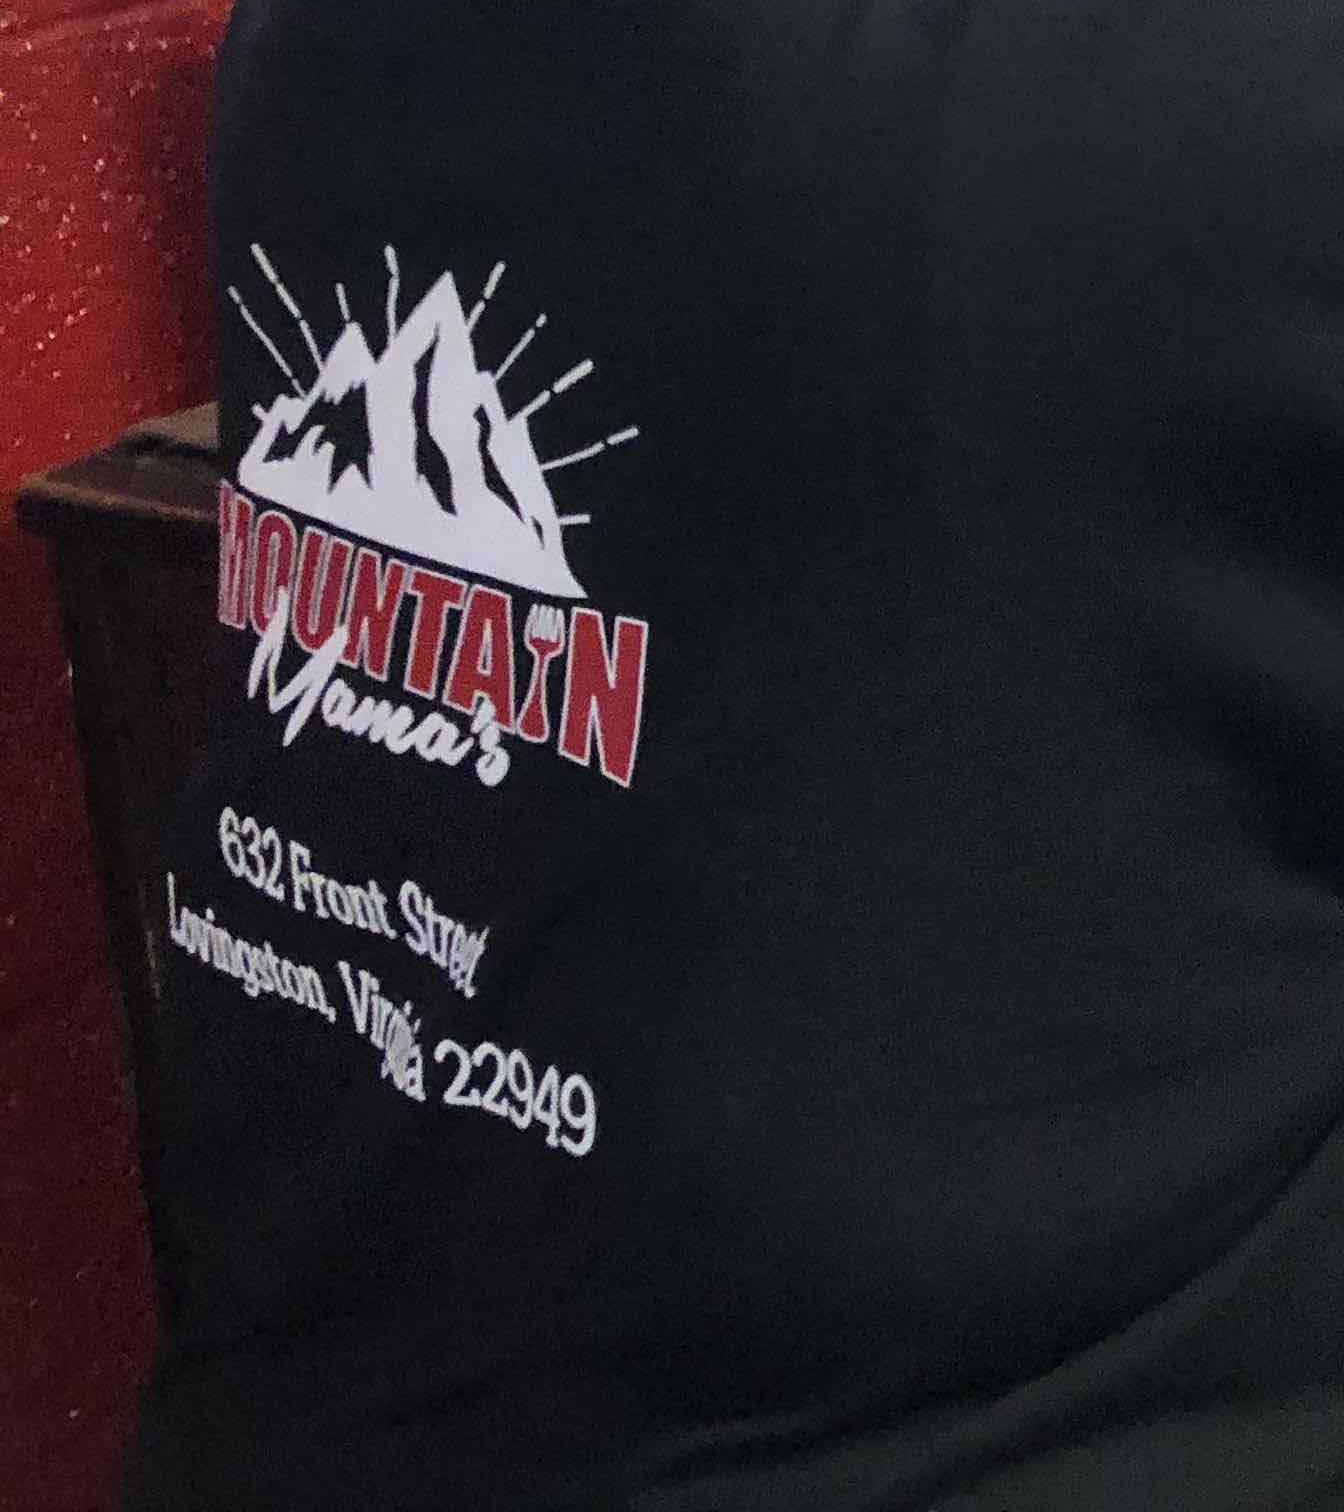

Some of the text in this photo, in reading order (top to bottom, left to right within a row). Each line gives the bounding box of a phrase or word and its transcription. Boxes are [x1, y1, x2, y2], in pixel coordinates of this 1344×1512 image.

[218, 806, 286, 902] 632
[289, 840, 398, 939] Front
[434, 1038, 597, 1157] 22949
